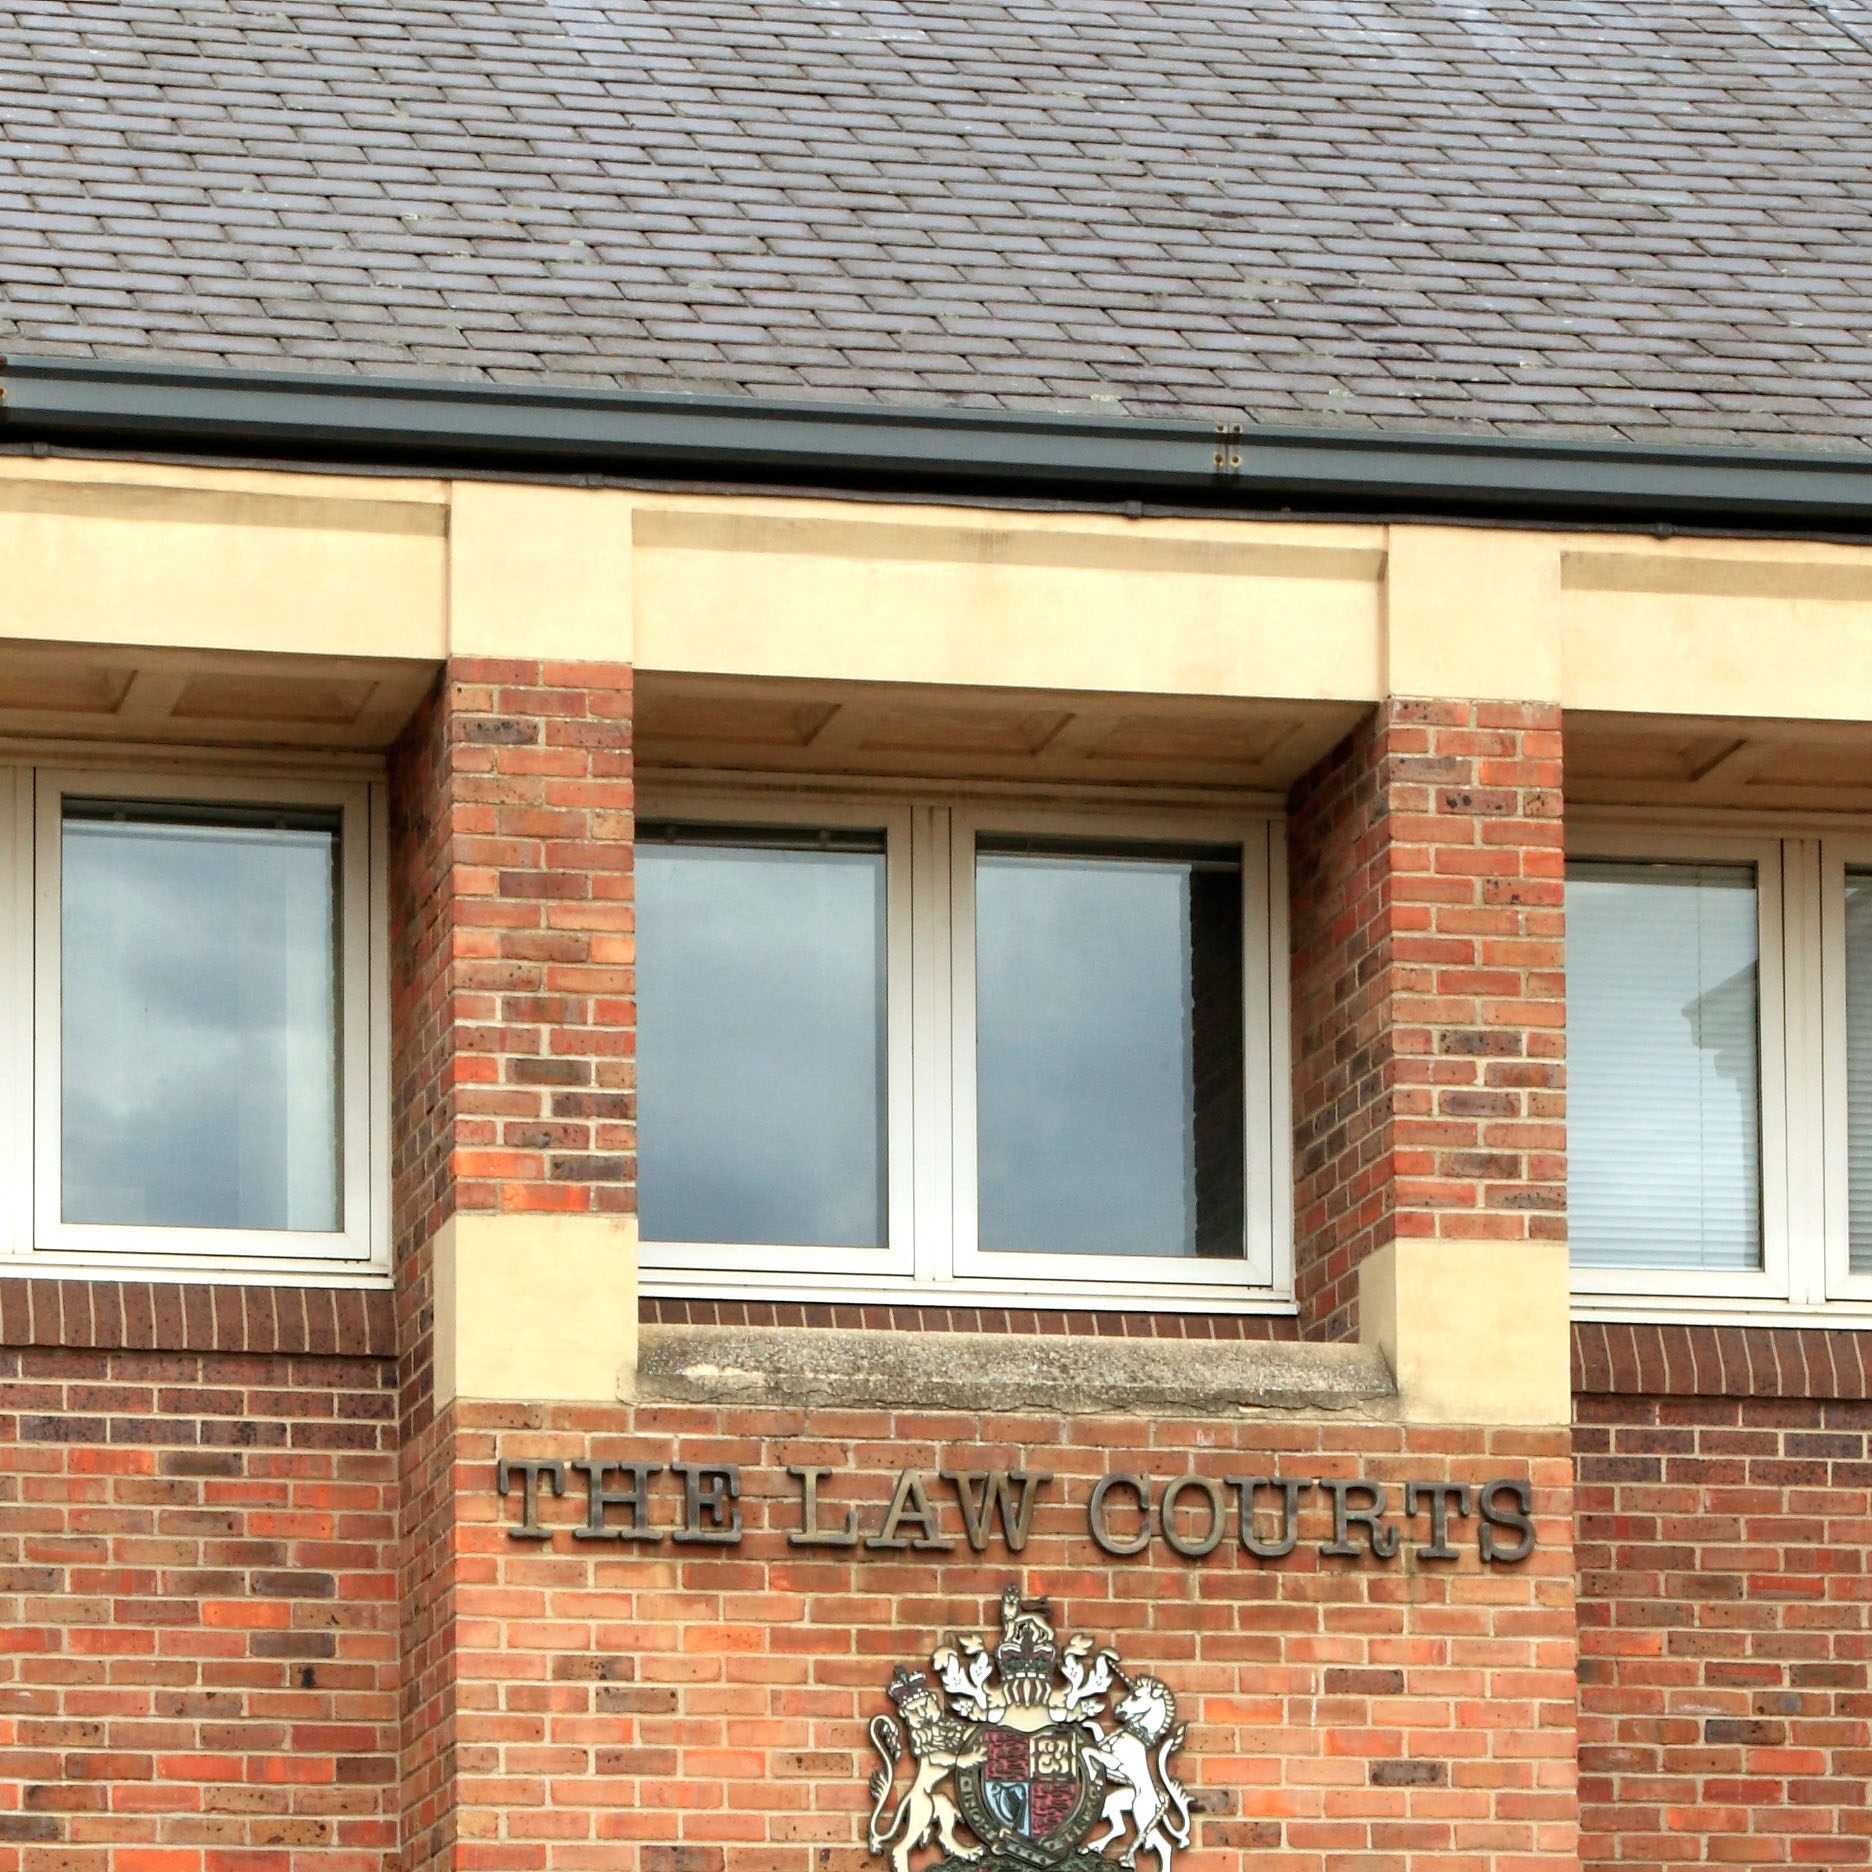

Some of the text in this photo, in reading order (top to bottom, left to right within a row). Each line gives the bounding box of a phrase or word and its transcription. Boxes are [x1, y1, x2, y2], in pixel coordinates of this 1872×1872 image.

[498, 1458, 1536, 1563] THE LAW COURTS
